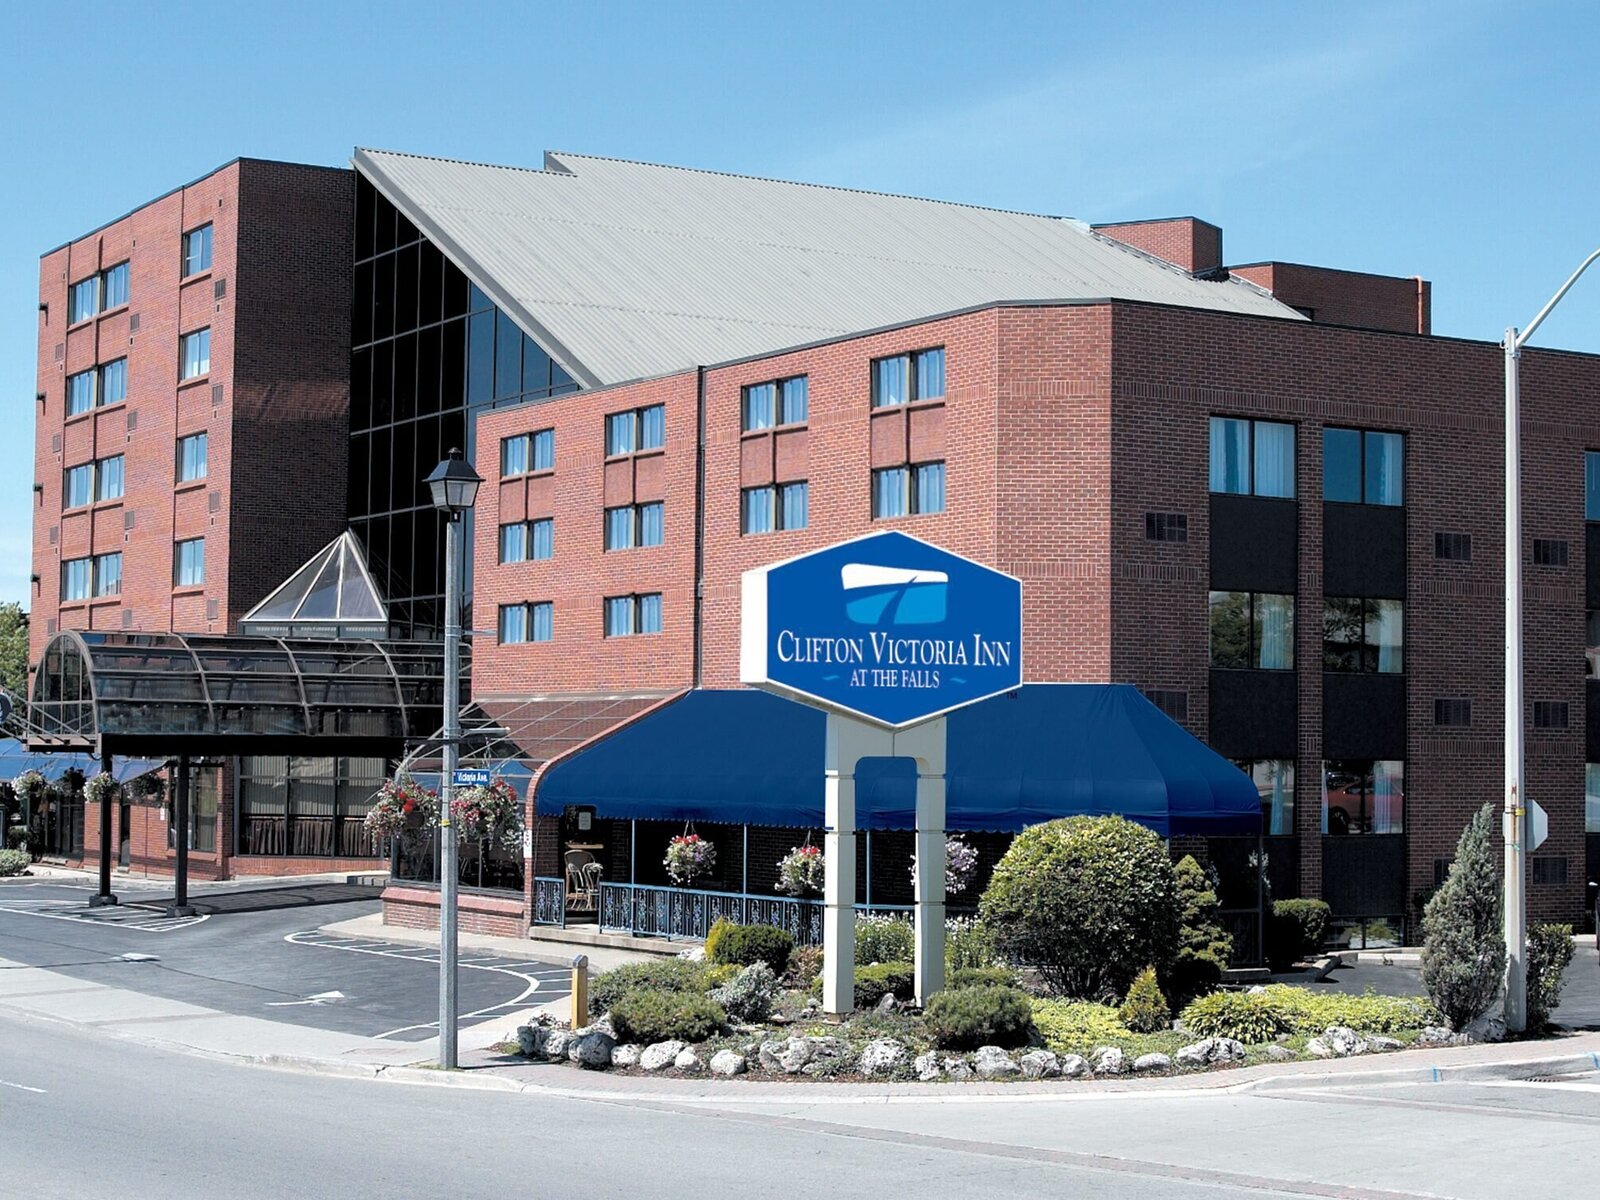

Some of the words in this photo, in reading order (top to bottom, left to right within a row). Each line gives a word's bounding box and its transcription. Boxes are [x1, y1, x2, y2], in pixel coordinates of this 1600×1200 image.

[777, 630, 864, 664] CLIFTON
[869, 631, 968, 666] VICTORIA
[973, 633, 1012, 667] INN
[850, 668, 868, 687] AT
[871, 669, 898, 688] THE
[901, 669, 940, 689] FALLS
[457, 772, 476, 781] Victoria
